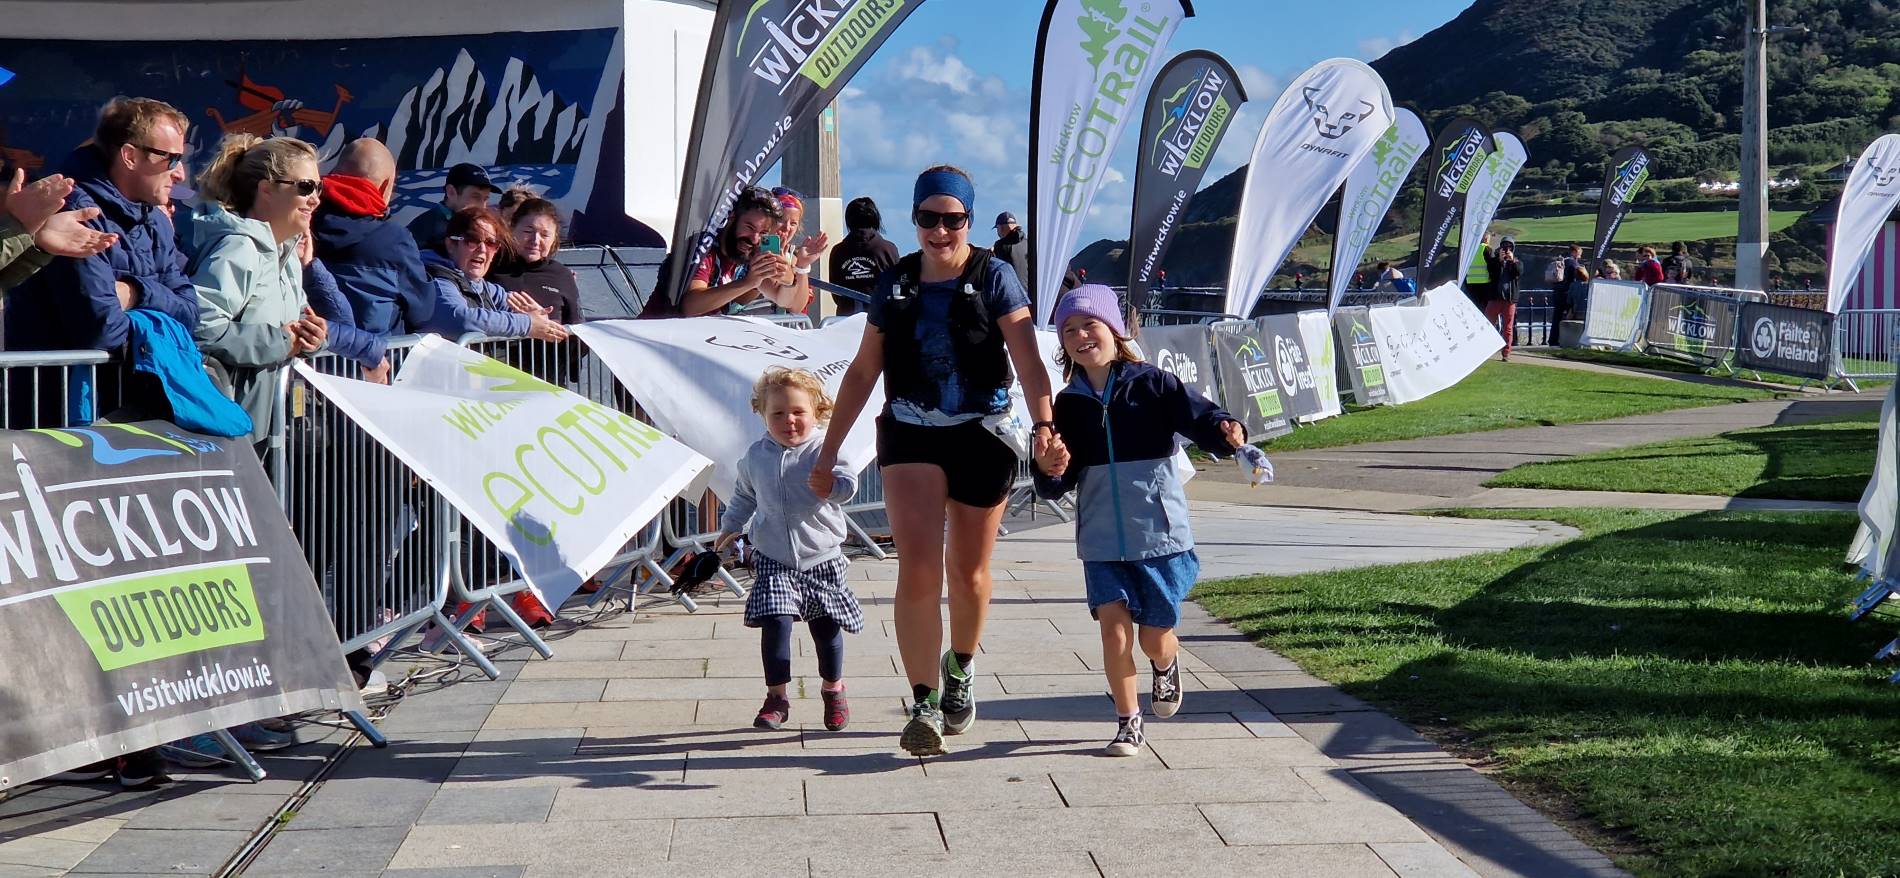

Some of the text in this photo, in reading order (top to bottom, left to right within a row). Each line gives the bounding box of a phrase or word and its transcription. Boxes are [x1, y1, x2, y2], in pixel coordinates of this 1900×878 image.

[1050, 103, 1082, 165] Wicklow
[1161, 69, 1224, 178] WICKLOW
[1191, 104, 1227, 163] OUTDOORS
[1301, 143, 1350, 159] DYNAFIT
[1440, 129, 1484, 198] WICKLOW
[1460, 152, 1485, 191] OUTDOORS
[1611, 153, 1649, 206] WICKLOW
[1139, 189, 1187, 283] visitwicklow.ie
[1424, 206, 1457, 269] visitwicklow.ie
[1668, 309, 1716, 340] WICKLOW
[1777, 341, 1819, 363] Ireland
[90, 578, 252, 653] OUTDOORS
[117, 658, 273, 717] visitwicklow.ie
